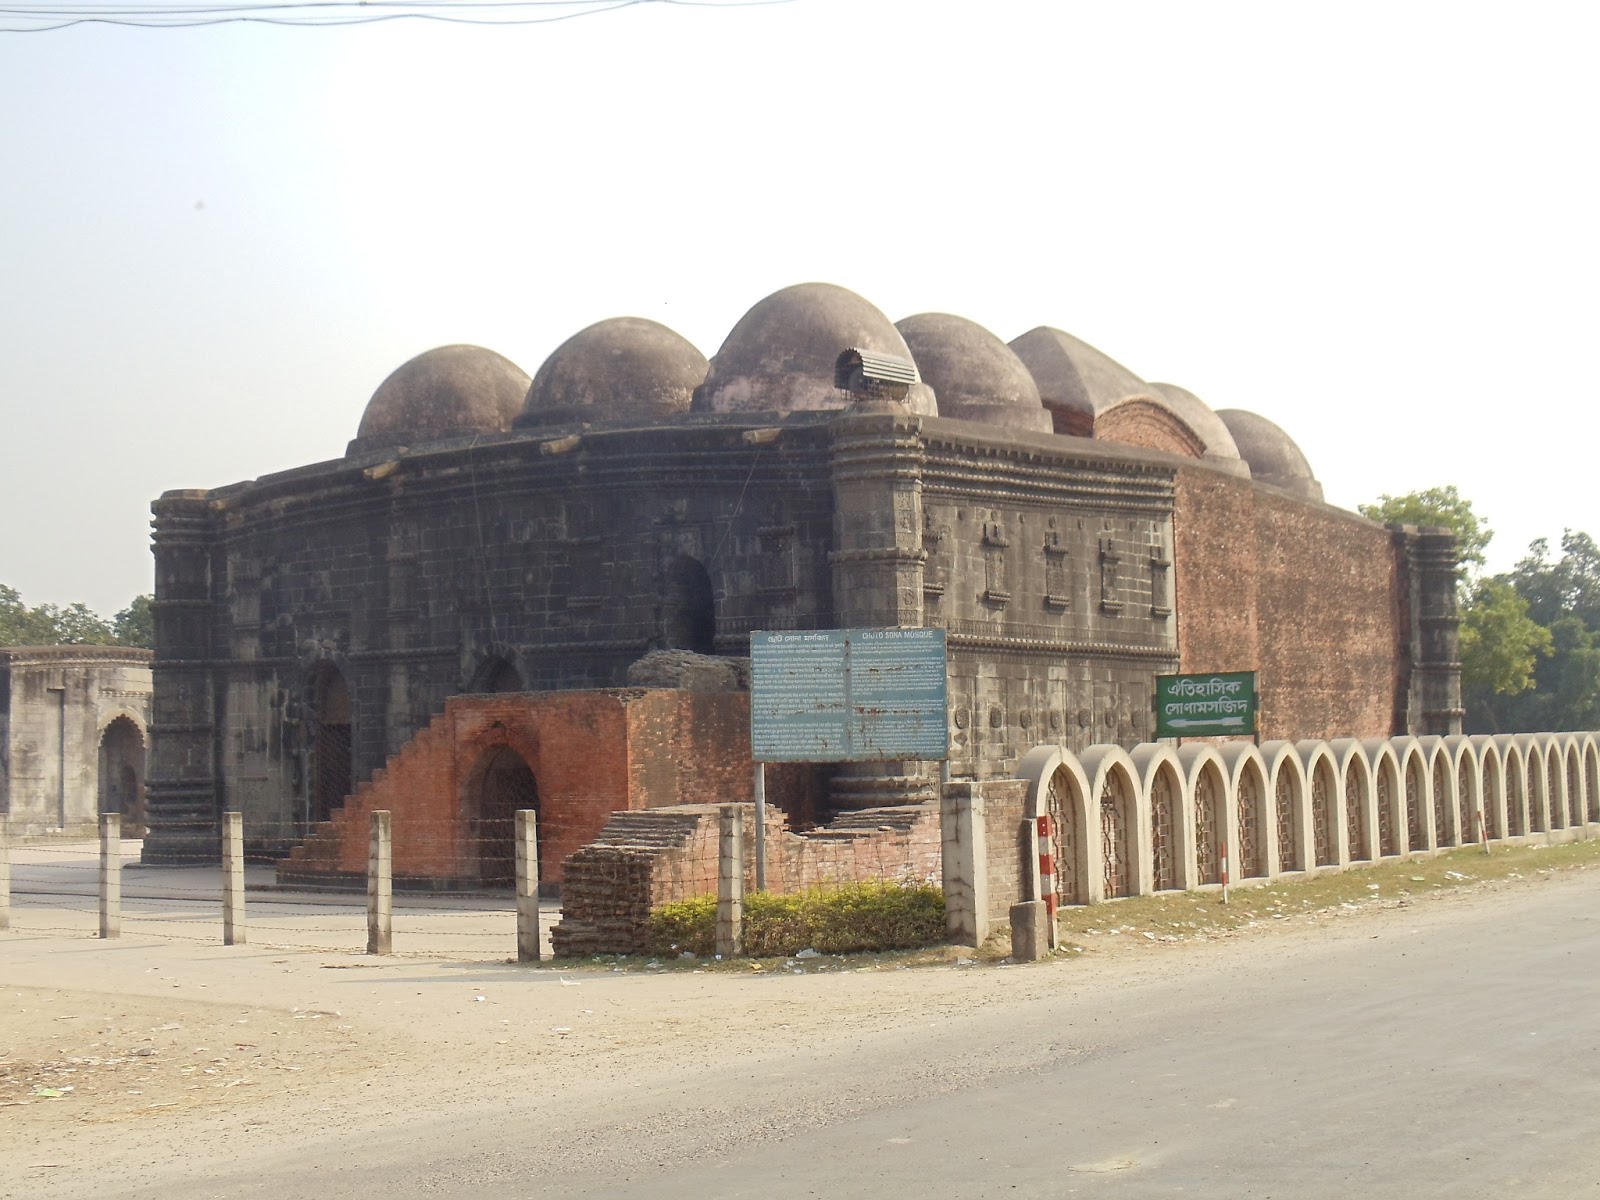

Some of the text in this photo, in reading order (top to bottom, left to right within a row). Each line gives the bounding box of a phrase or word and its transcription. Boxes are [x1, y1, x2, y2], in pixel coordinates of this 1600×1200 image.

[885, 631, 902, 639] SONA
[903, 630, 933, 639] MOSQUE
[1167, 678, 1242, 697] ঐতিহাসিক
